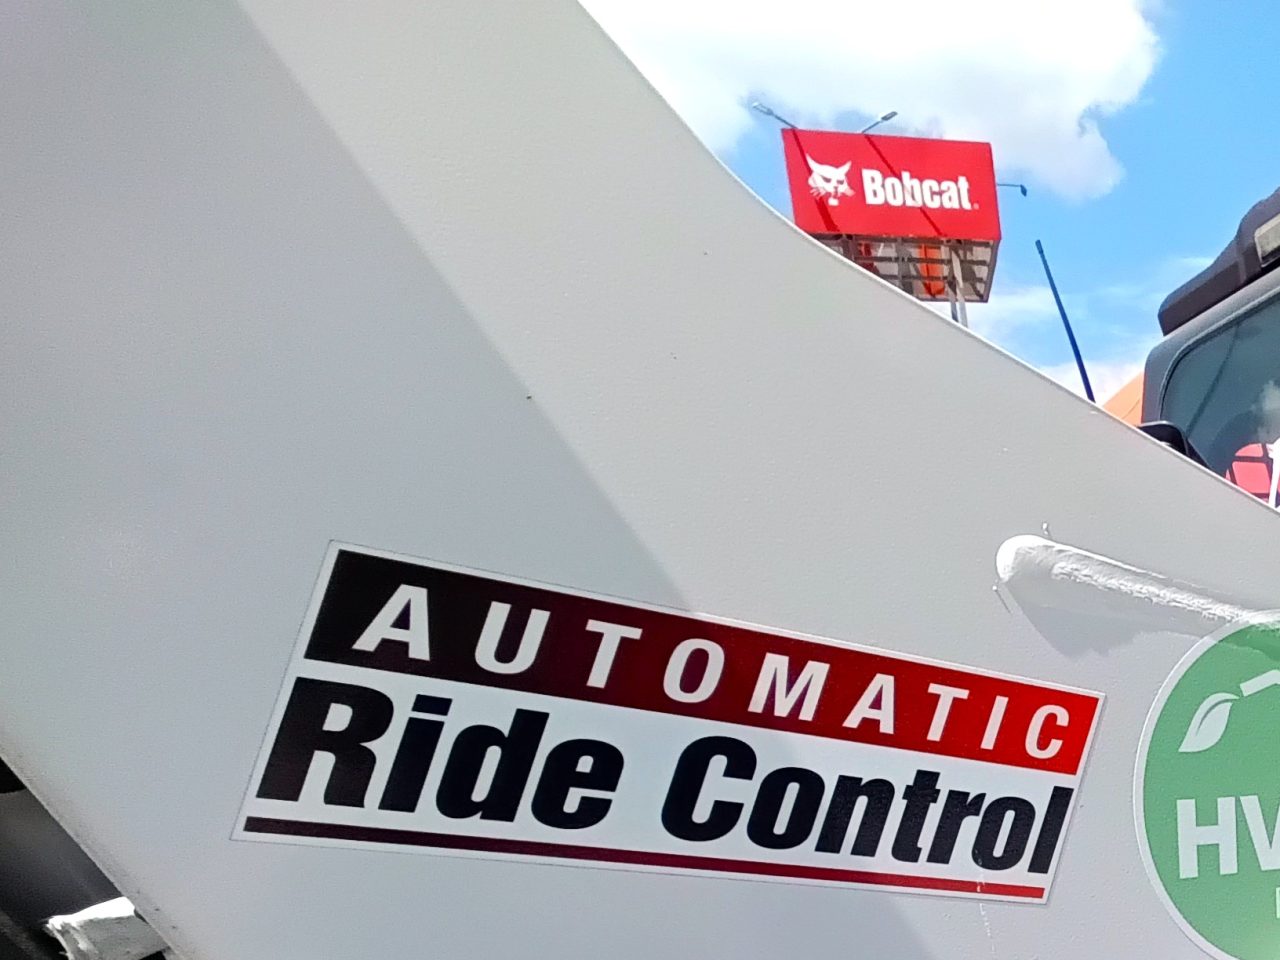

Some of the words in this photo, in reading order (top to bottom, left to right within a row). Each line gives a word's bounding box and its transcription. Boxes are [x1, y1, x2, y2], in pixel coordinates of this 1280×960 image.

[861, 168, 973, 210] Bobcat
[353, 583, 1074, 760] AUTOMATIC
[255, 676, 624, 831] Ride
[660, 735, 1074, 874] Control
